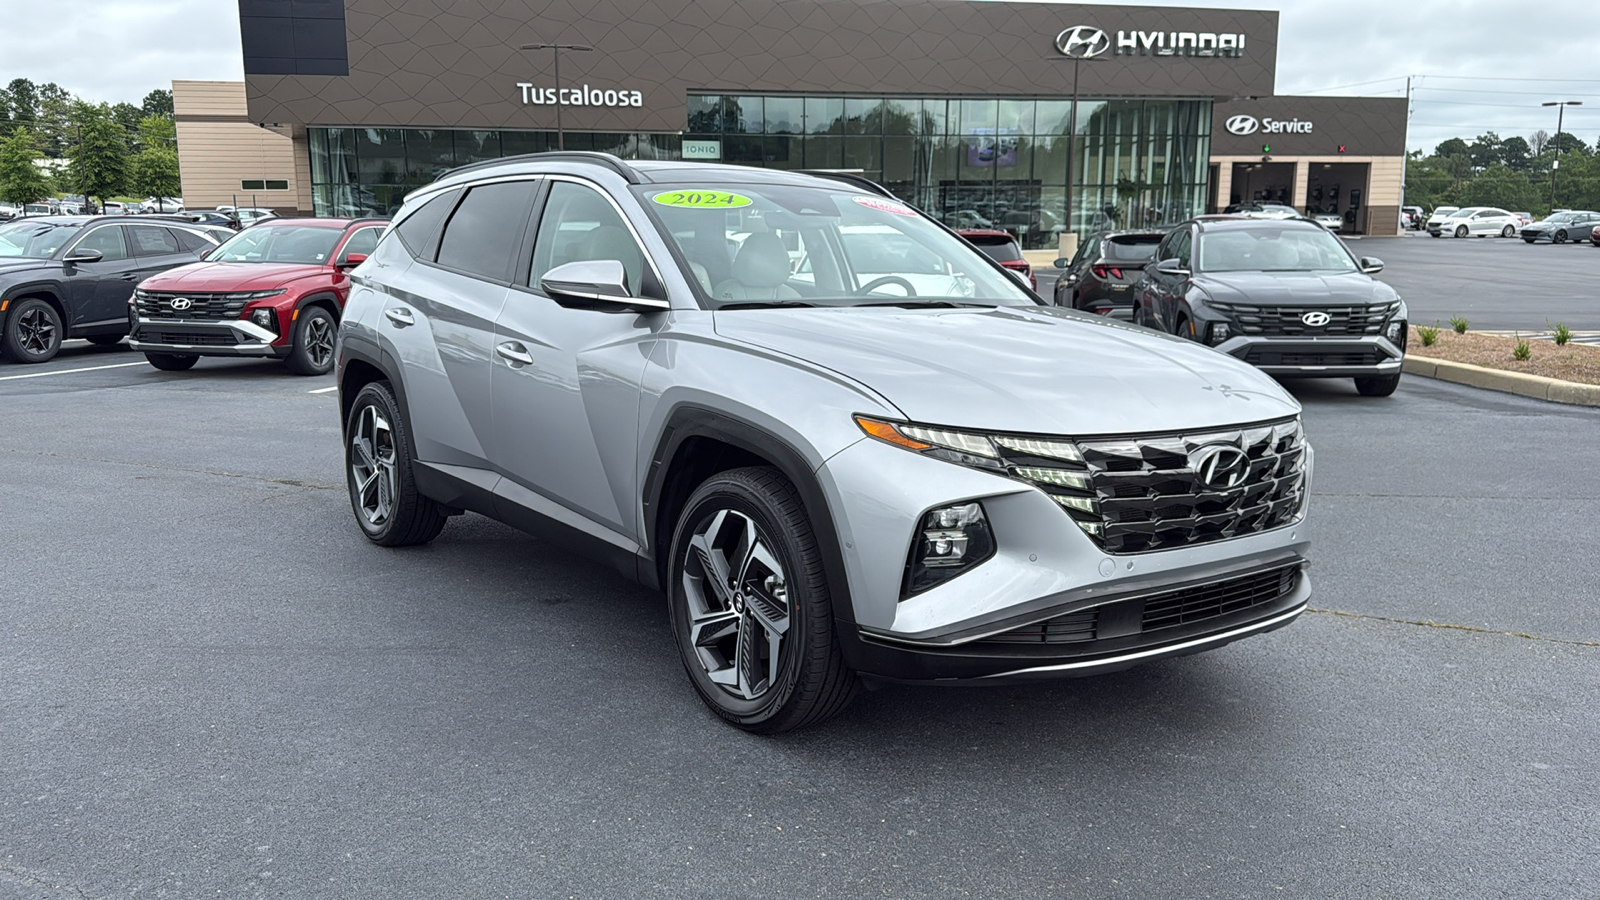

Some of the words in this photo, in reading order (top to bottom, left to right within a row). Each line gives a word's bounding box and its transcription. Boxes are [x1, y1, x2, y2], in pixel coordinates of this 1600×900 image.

[1116, 30, 1246, 57] HYUNDAI
[516, 82, 643, 107] Tuscaloosa
[1261, 118, 1313, 134] Service
[671, 193, 735, 205] 2024
